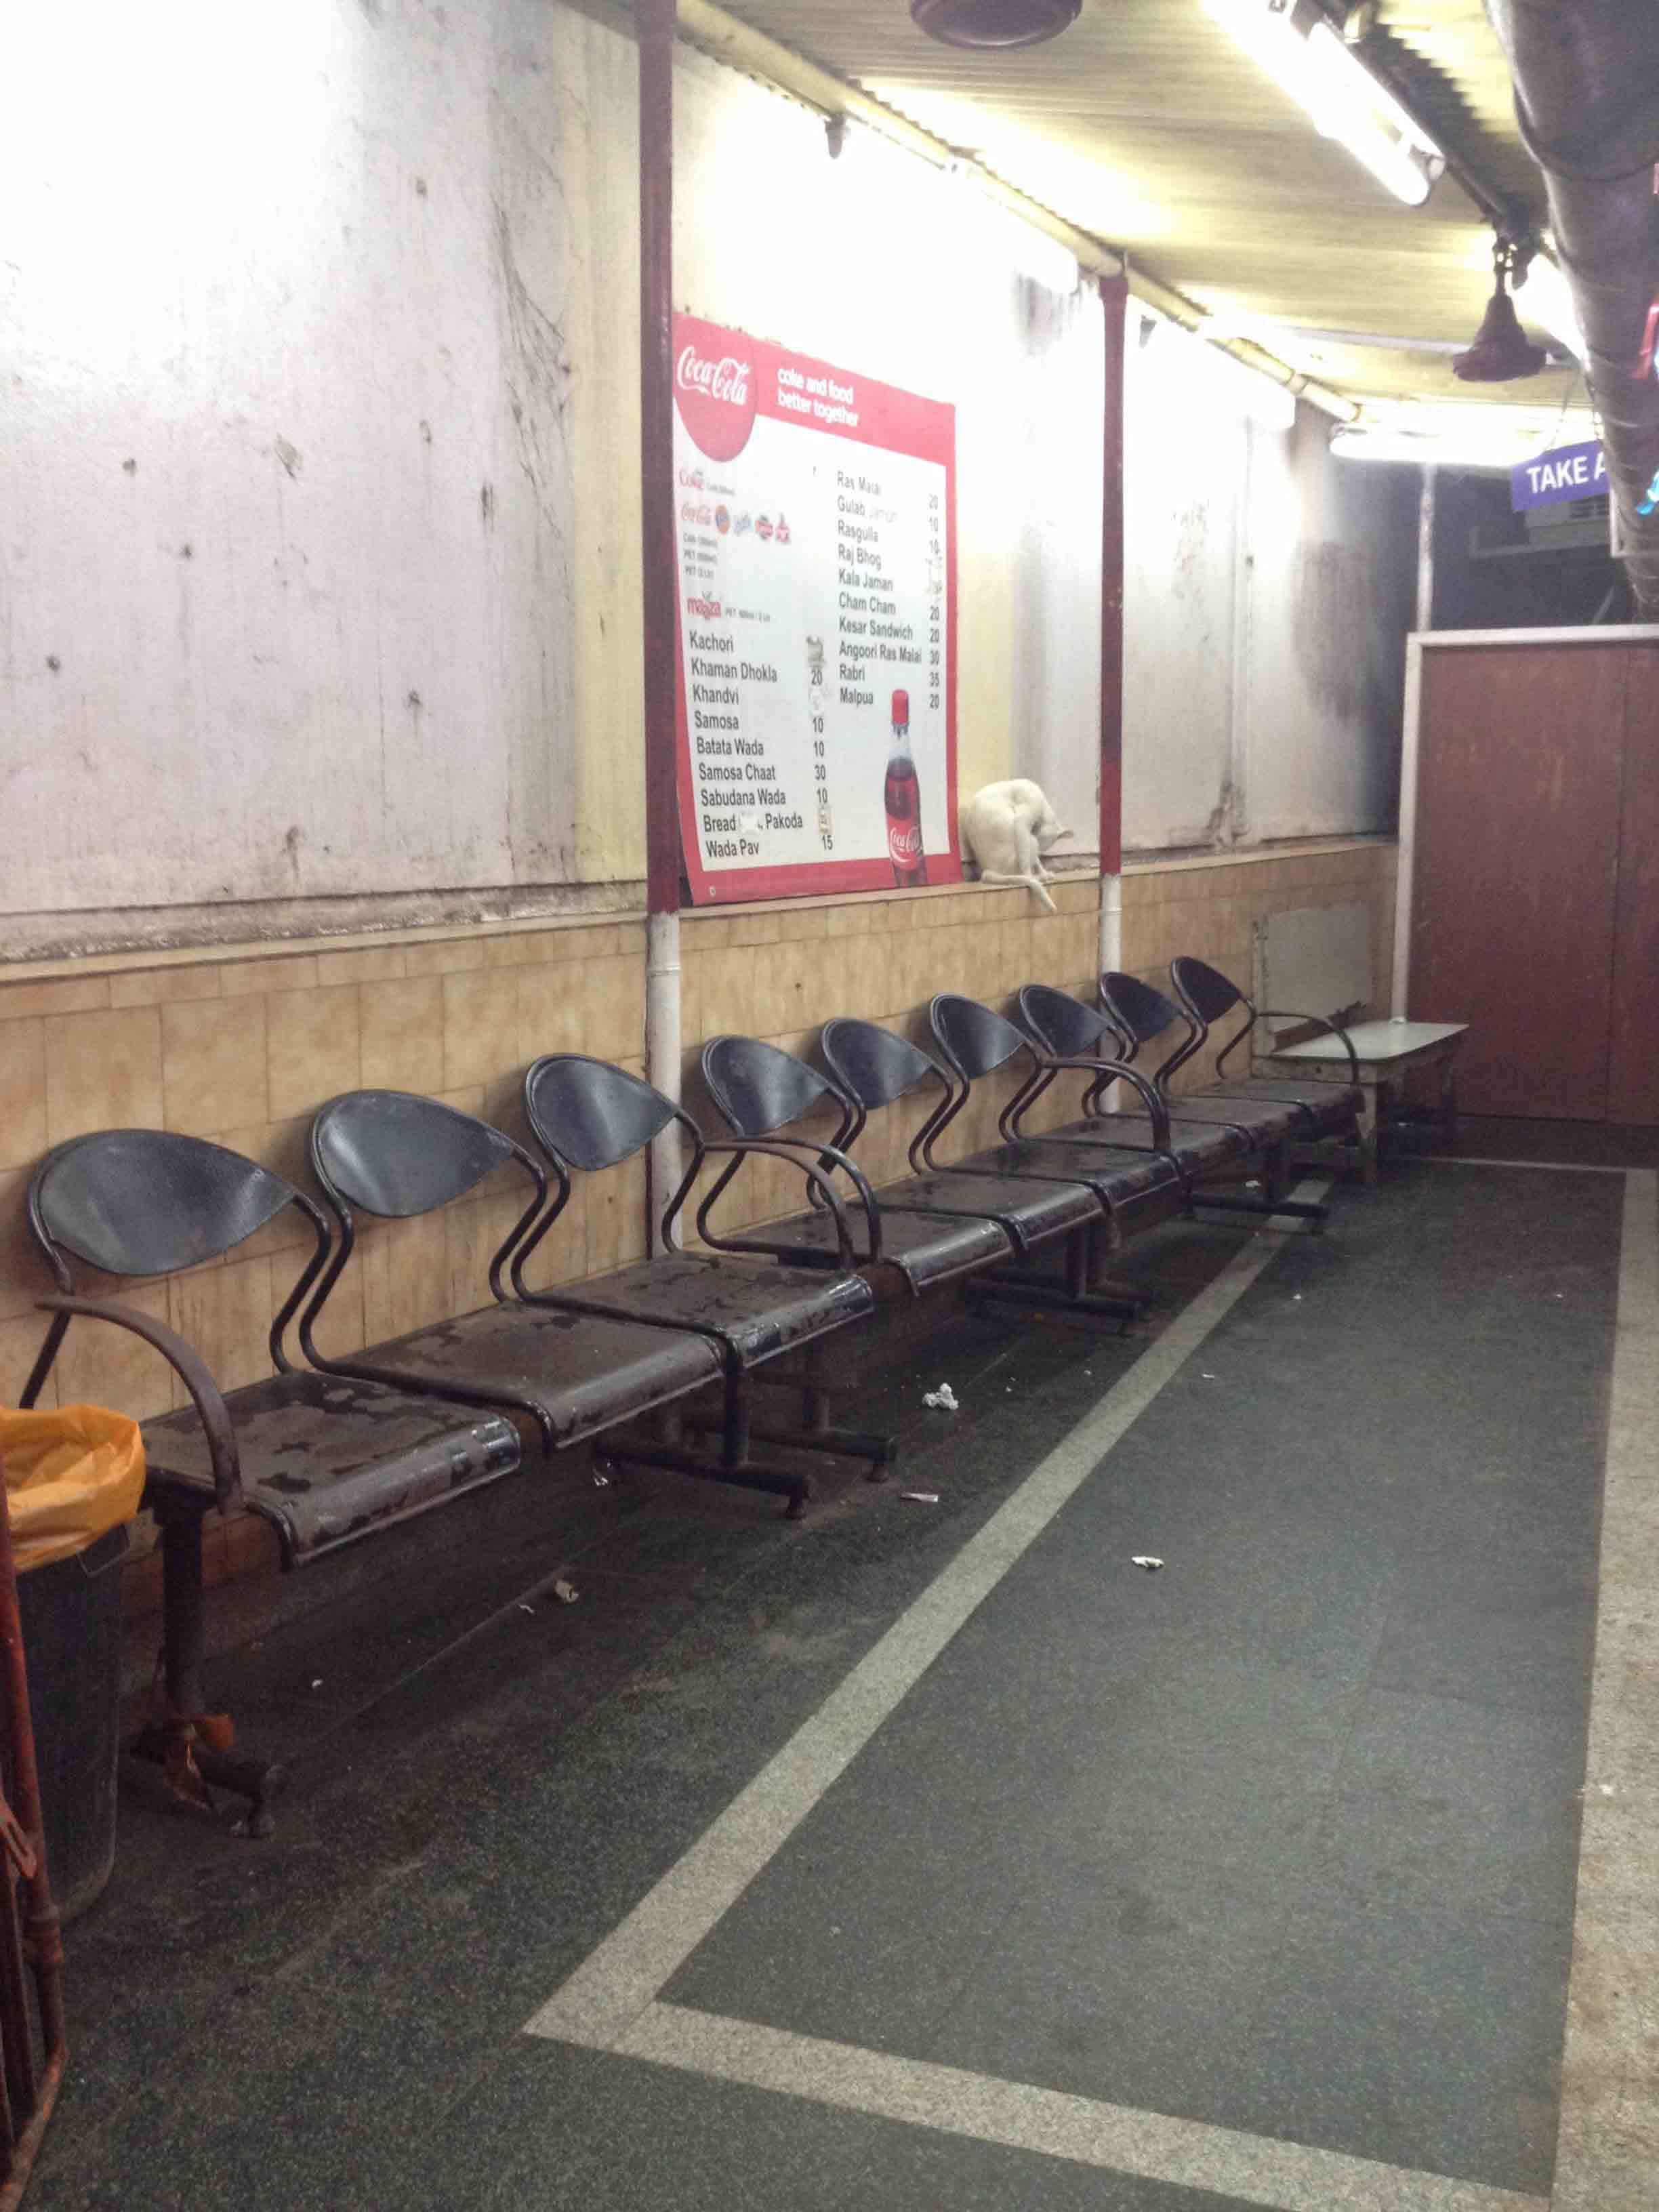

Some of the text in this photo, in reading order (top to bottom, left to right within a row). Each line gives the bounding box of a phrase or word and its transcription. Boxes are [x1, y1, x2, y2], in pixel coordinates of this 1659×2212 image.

[777, 369, 853, 405] coke and food
[777, 388, 858, 428] better together
[1526, 455, 1589, 493] TAKE
[838, 470, 854, 489] Ras
[929, 493, 939, 510] 20
[838, 495, 865, 515] Gulab
[929, 516, 939, 532] 10
[838, 520, 879, 544] Rasgulla
[838, 543, 881, 571] Raj Bhog
[839, 569, 893, 592] Kala Jaman
[839, 591, 939, 621] Cham Cham 20
[689, 630, 734, 652] Kachori
[840, 616, 939, 643] Kesar Sandwich 20
[839, 641, 939, 665] Angoori Ras Malai 30
[691, 657, 823, 685] Khaman Dhokla 20
[840, 663, 939, 687] Rabri 35
[693, 684, 739, 705] Khandvi
[840, 687, 939, 709] Malpua 20
[695, 710, 823, 733] Samosa 10
[697, 736, 825, 757] Batata Wada 10
[699, 762, 826, 780] Samosa Chaat 30
[701, 787, 827, 806] Sabudana Wada 10
[703, 814, 736, 832] Bread
[765, 812, 803, 830] Pakoda
[706, 834, 833, 858] Wada Pav 15
